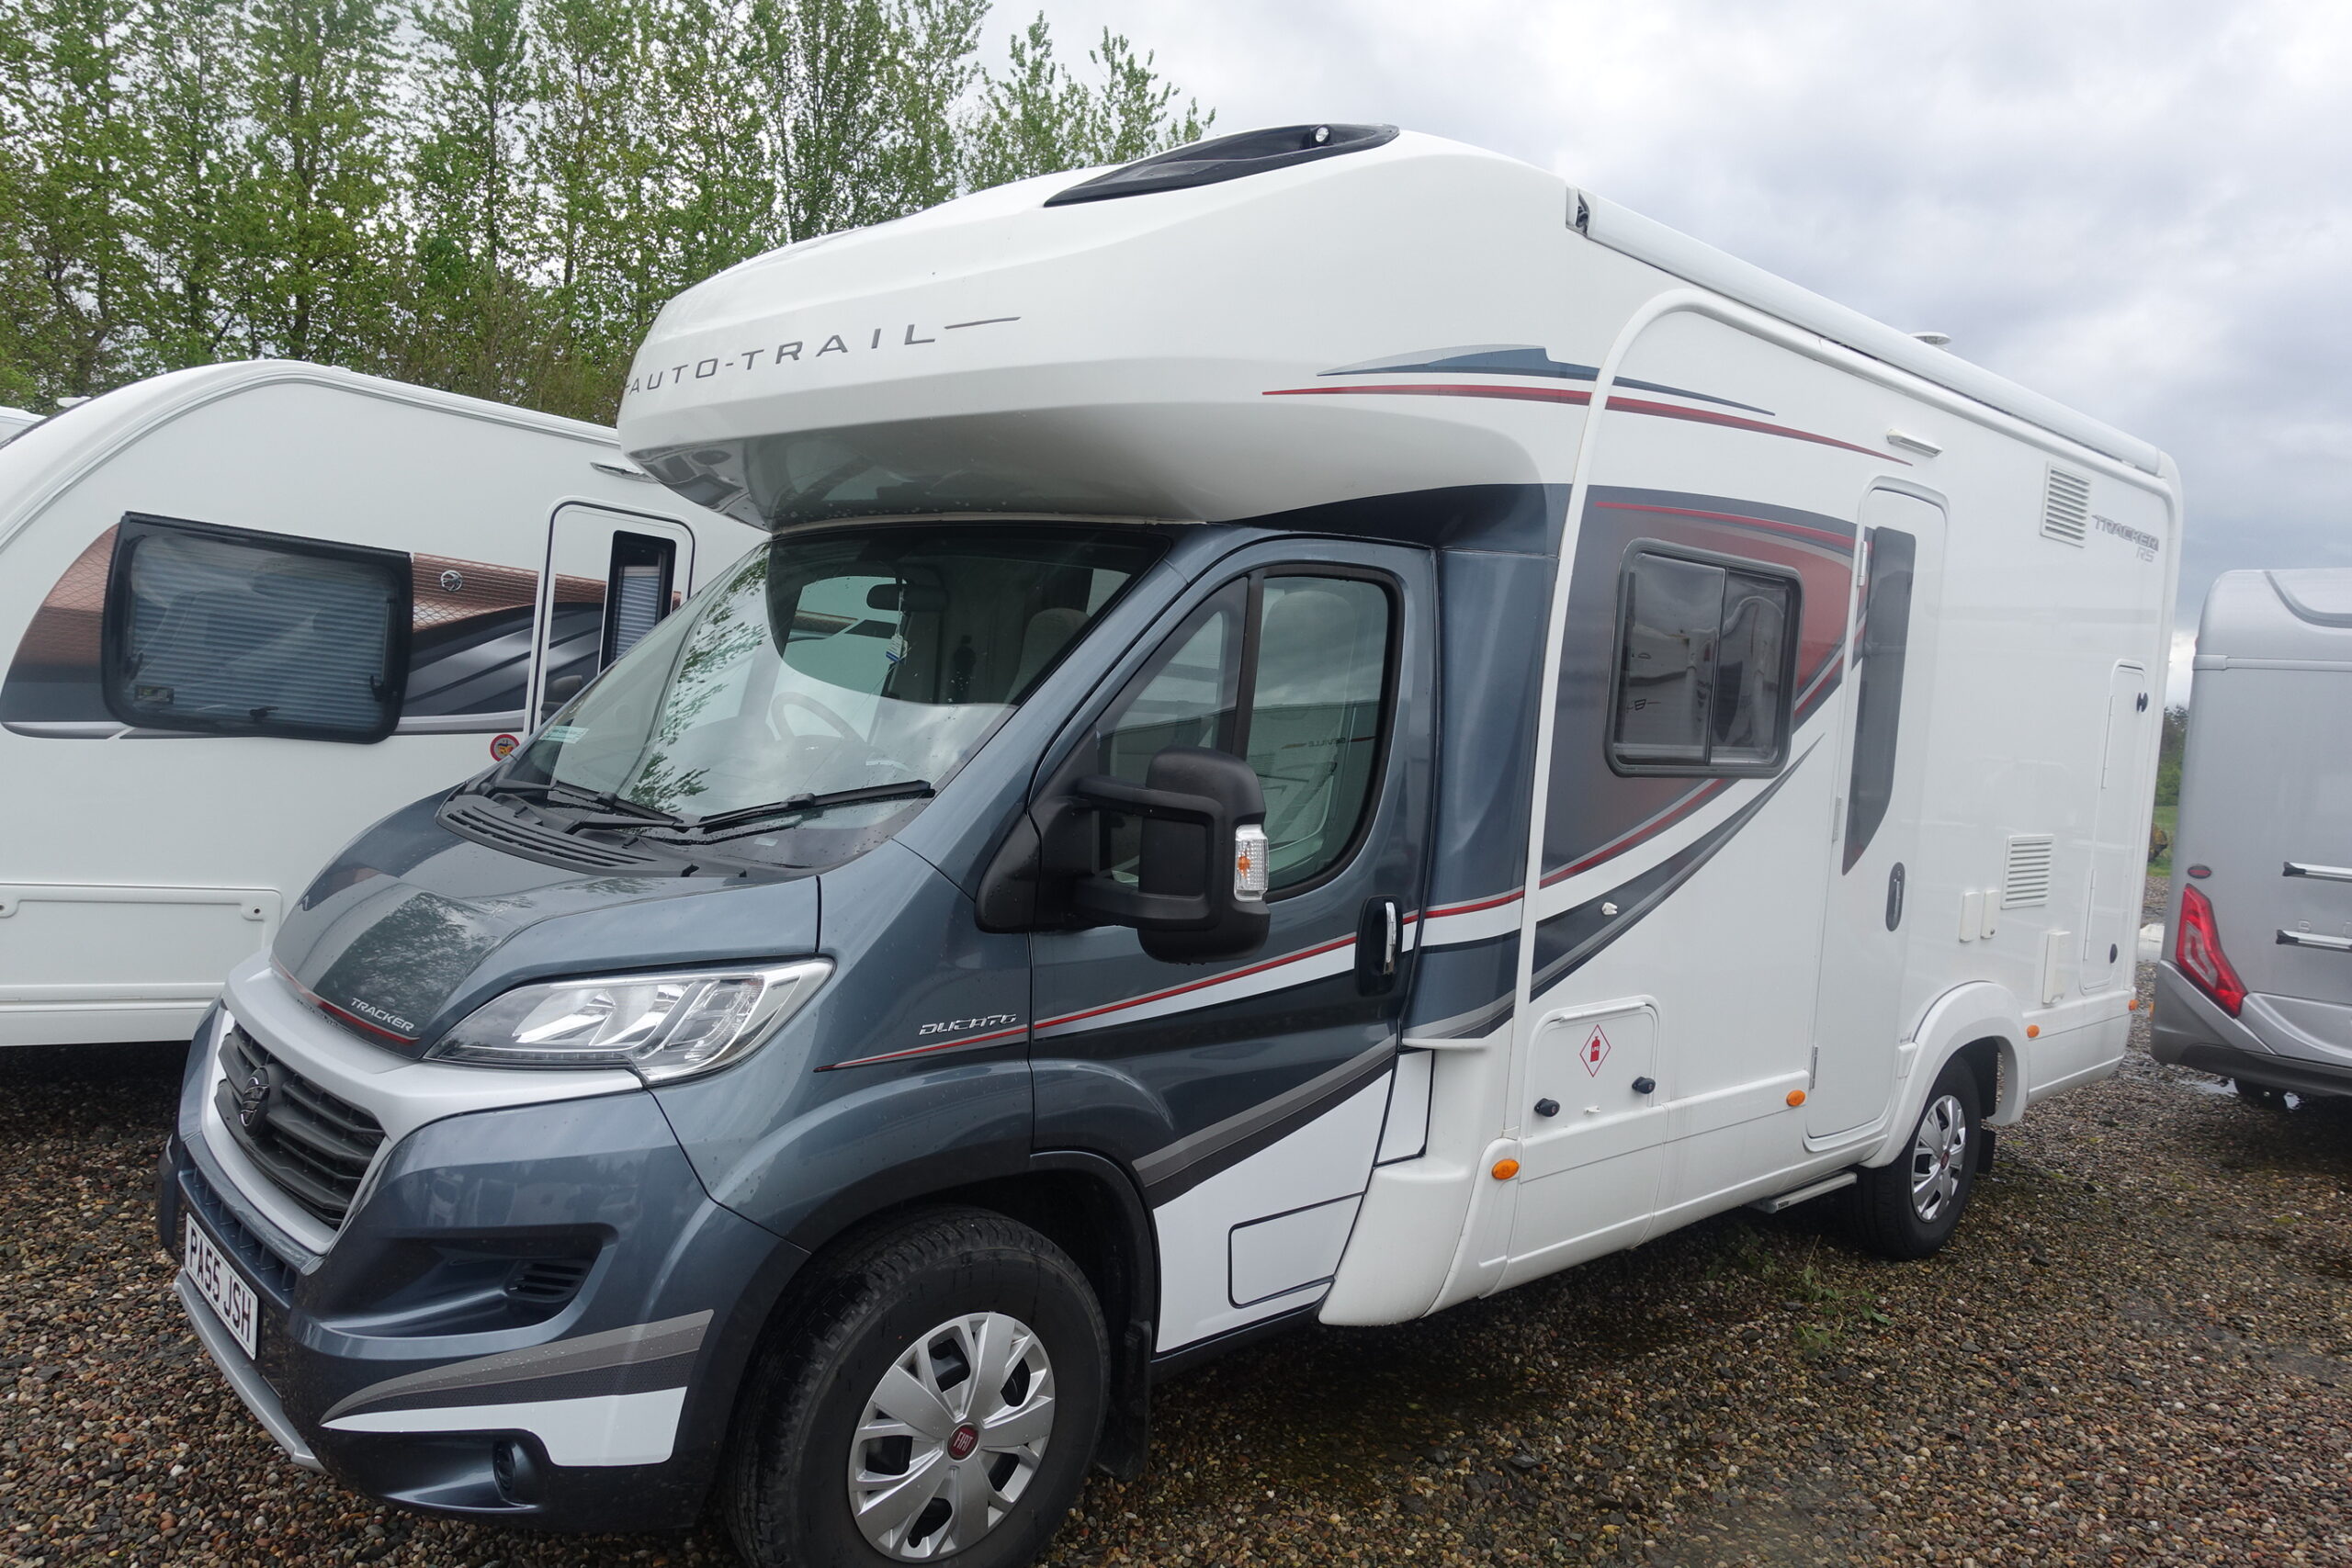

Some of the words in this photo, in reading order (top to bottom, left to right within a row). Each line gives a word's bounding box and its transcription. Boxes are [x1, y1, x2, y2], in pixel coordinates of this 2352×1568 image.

[628, 323, 936, 395] AUTO-TRAIL
[2092, 514, 2159, 552] TRACKER
[2136, 547, 2155, 562] RS
[351, 998, 414, 1032] TRACKER
[919, 1014, 1016, 1035] DUCATO
[189, 1226, 221, 1303] PA55
[223, 1275, 251, 1343] JSH
[953, 1431, 973, 1451] FIAT
